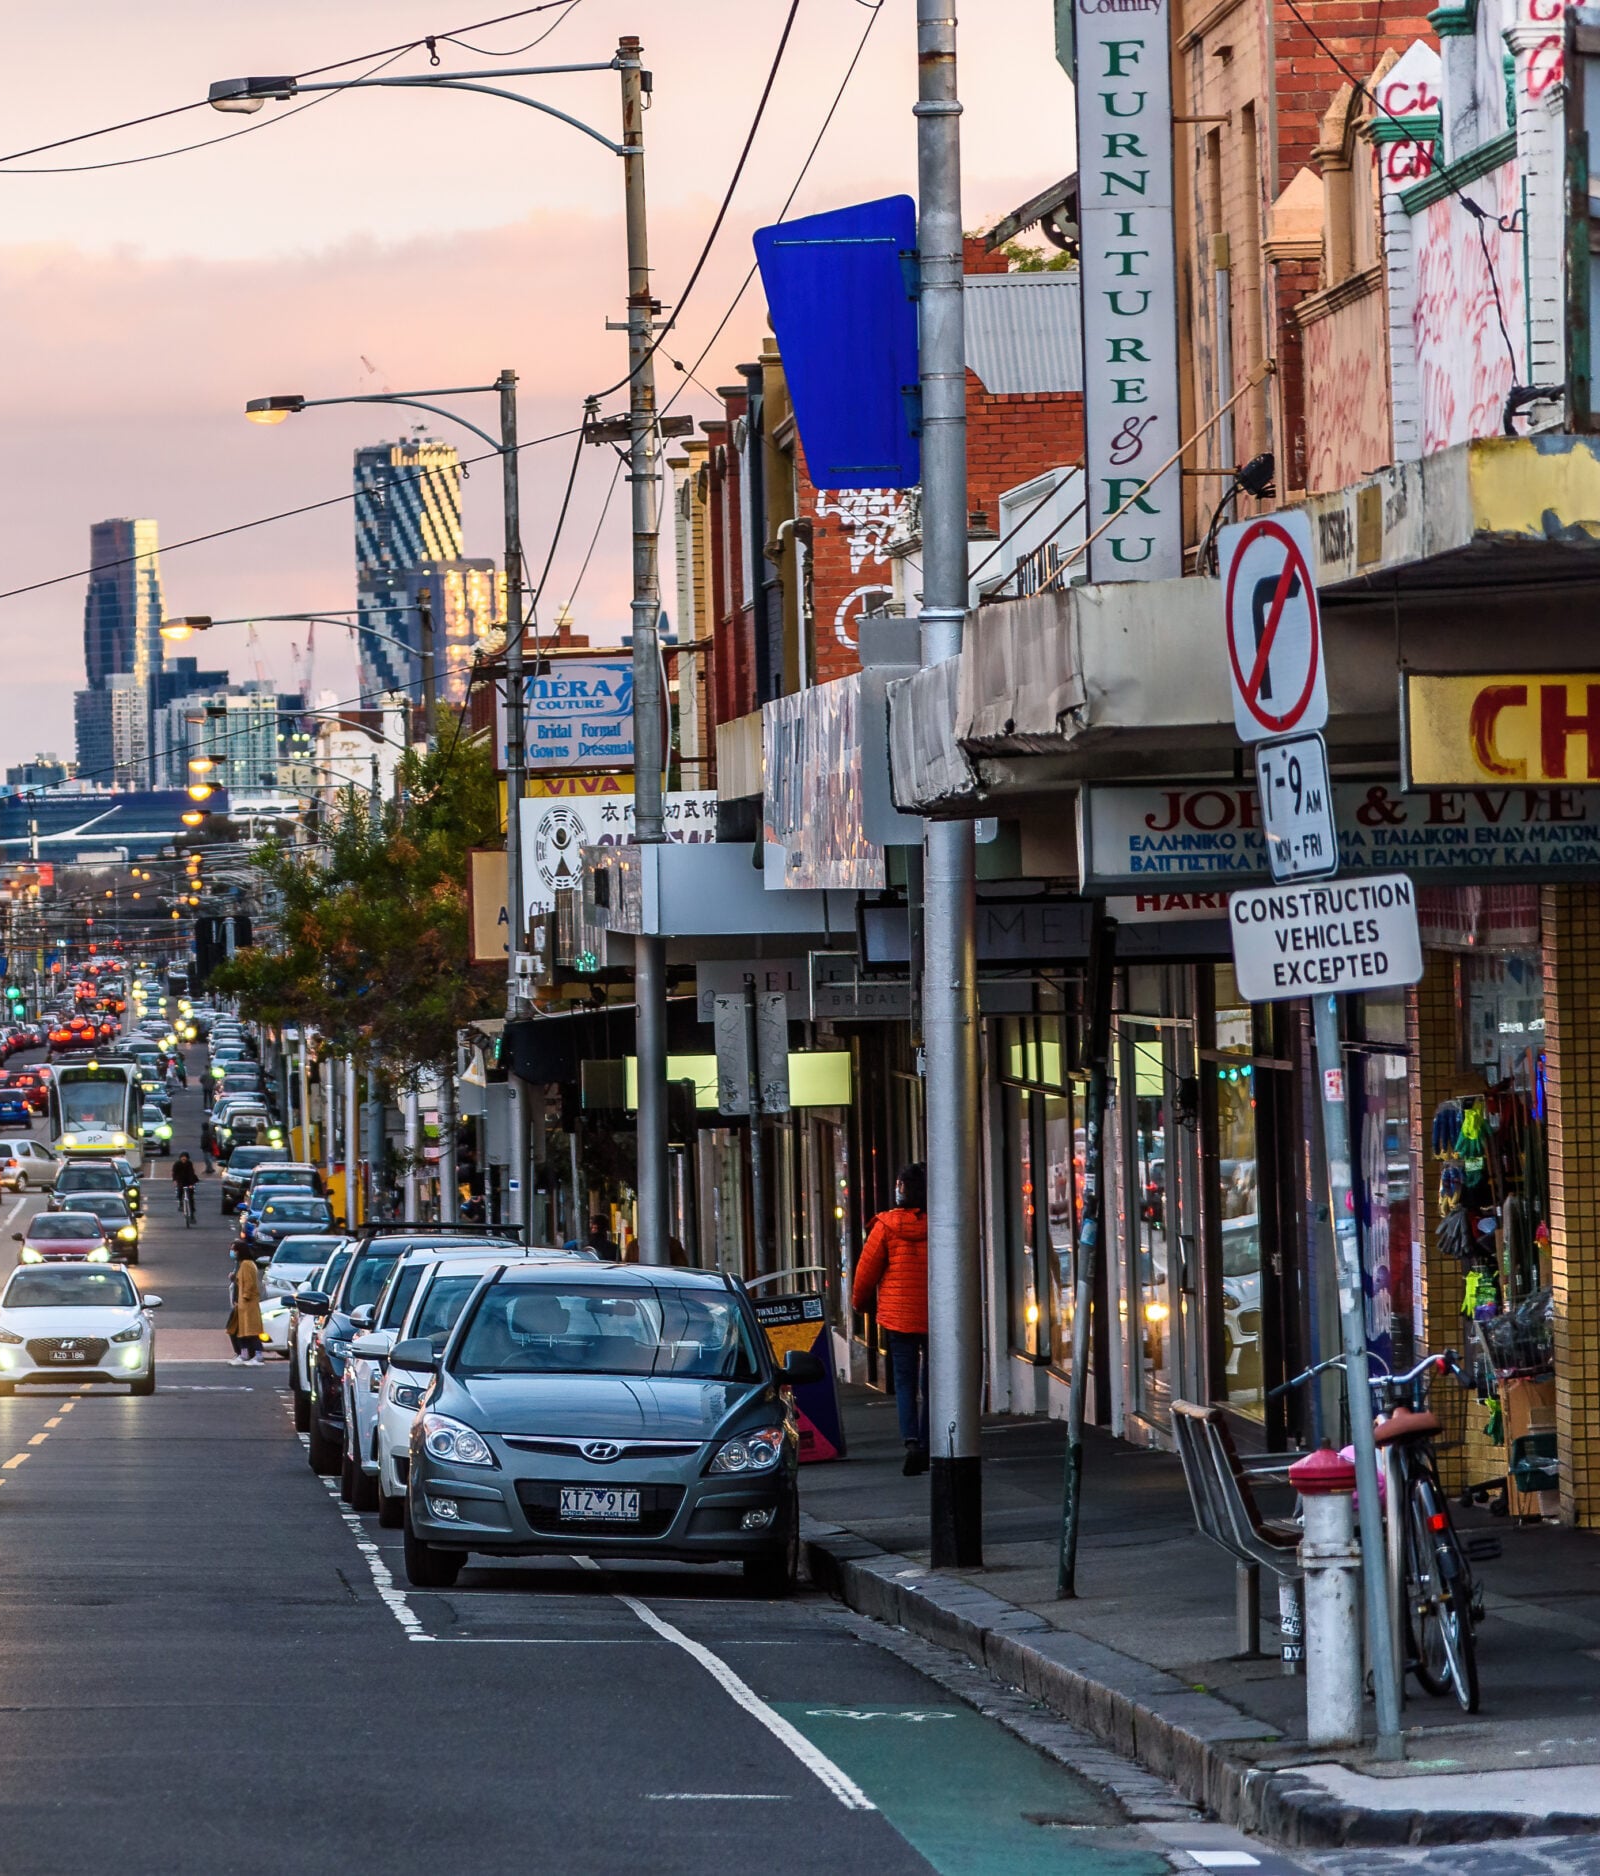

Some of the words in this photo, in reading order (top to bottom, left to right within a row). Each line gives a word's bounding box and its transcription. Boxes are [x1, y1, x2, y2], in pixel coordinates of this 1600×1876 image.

[1098, 40, 1151, 404] FURNITURE
[536, 700, 605, 710] COUTURE
[537, 724, 572, 739] Bridal
[581, 722, 621, 738] Formal
[530, 744, 569, 758] Gowns
[544, 777, 621, 794] VIVA
[1234, 882, 1411, 924] CONSTRUCTION
[1274, 919, 1379, 952] VEHICLES
[1273, 952, 1388, 986] EXCEPTED
[562, 1491, 593, 1510] XTZ
[607, 1493, 638, 1511] 914
